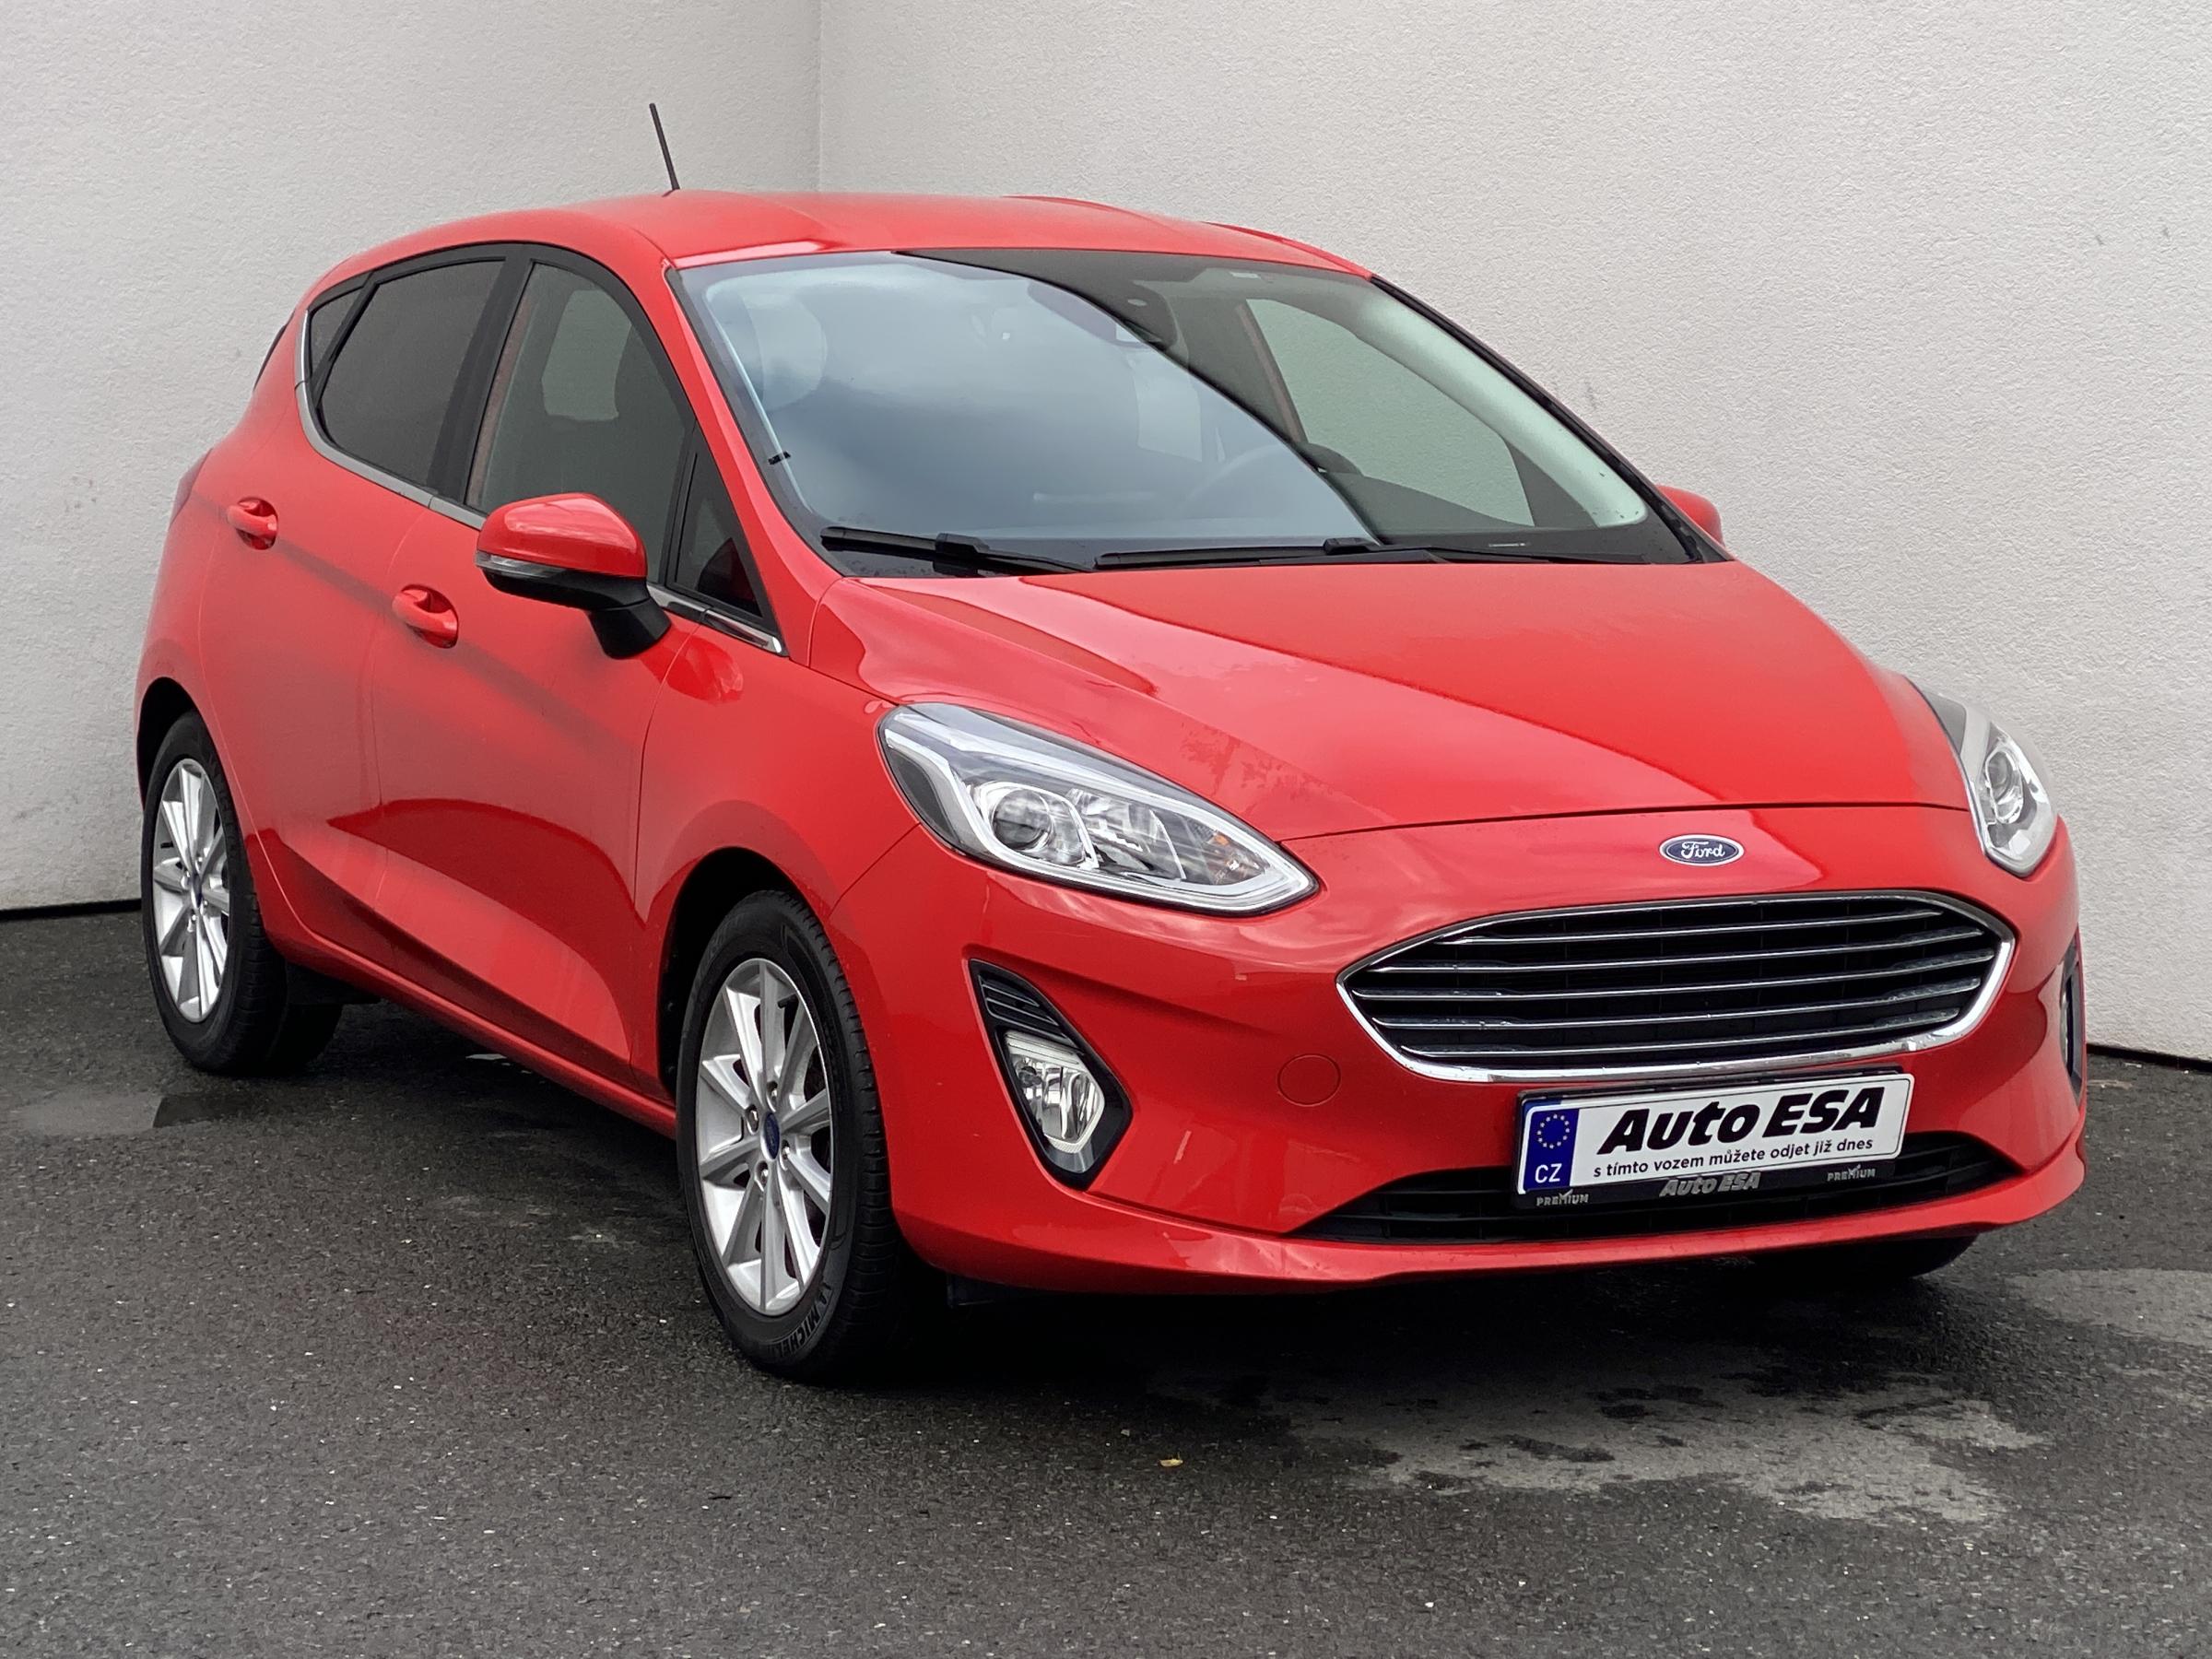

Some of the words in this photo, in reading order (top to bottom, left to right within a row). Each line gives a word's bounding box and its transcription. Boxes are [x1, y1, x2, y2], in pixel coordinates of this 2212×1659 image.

[1680, 841, 1725, 859] Ford
[1596, 1101, 1760, 1156] Auto
[1762, 1086, 1886, 1138] ESA
[1594, 1167, 1602, 1178] s
[1606, 1160, 1649, 1176] tímto
[1653, 1155, 1704, 1171] vozem
[1709, 1148, 1765, 1166] můžete
[1770, 1143, 1810, 1159] odjet
[1837, 1138, 1874, 1152] dnes
[1535, 1163, 1563, 1183] CZ
[1827, 1165, 1876, 1182] PREMIUM
[1659, 1176, 1718, 1197] Auto
[1718, 1171, 1762, 1193] ESA
[1536, 1191, 1590, 1206] PREMIUM
